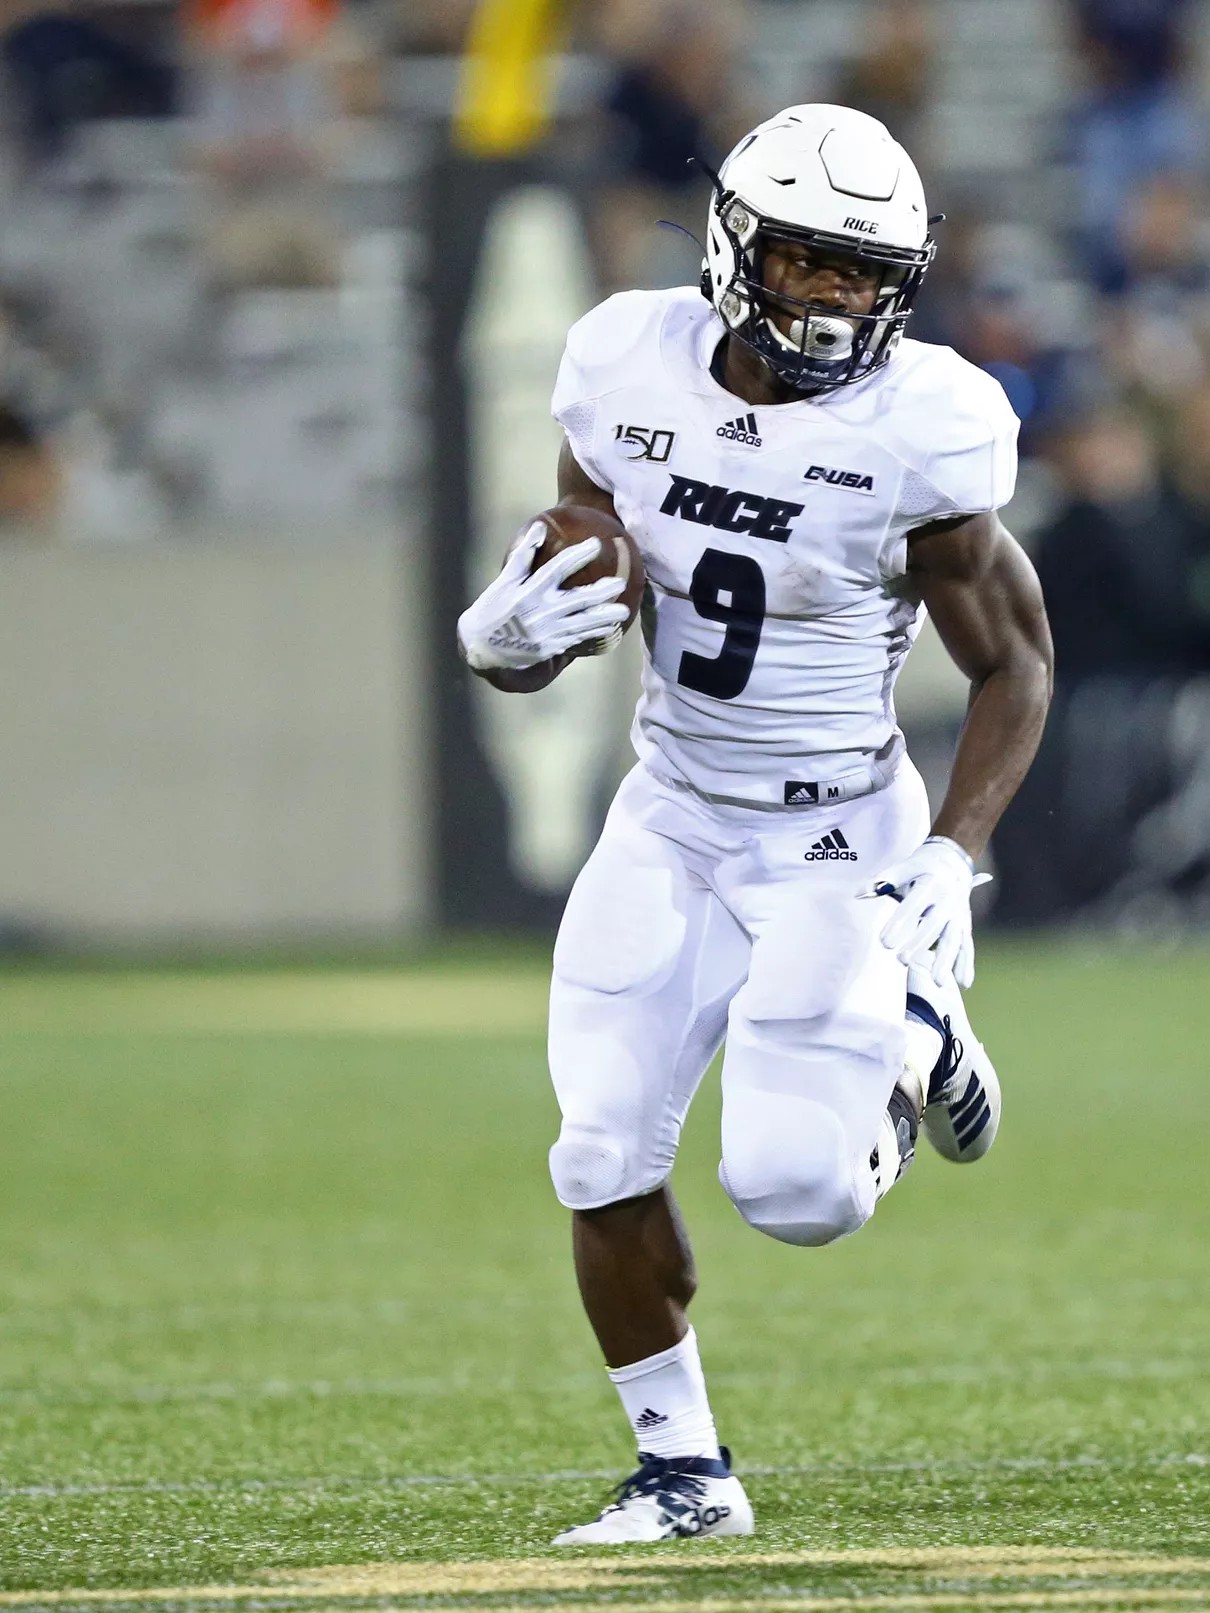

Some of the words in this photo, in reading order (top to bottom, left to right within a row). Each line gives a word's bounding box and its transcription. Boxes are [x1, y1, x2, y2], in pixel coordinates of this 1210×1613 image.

[843, 217, 879, 234] RICE
[615, 424, 675, 462] 150
[716, 427, 762, 447] adidas
[659, 473, 805, 543] RICE
[677, 547, 766, 700] 9
[828, 786, 839, 798] M
[804, 849, 858, 861] adidas
